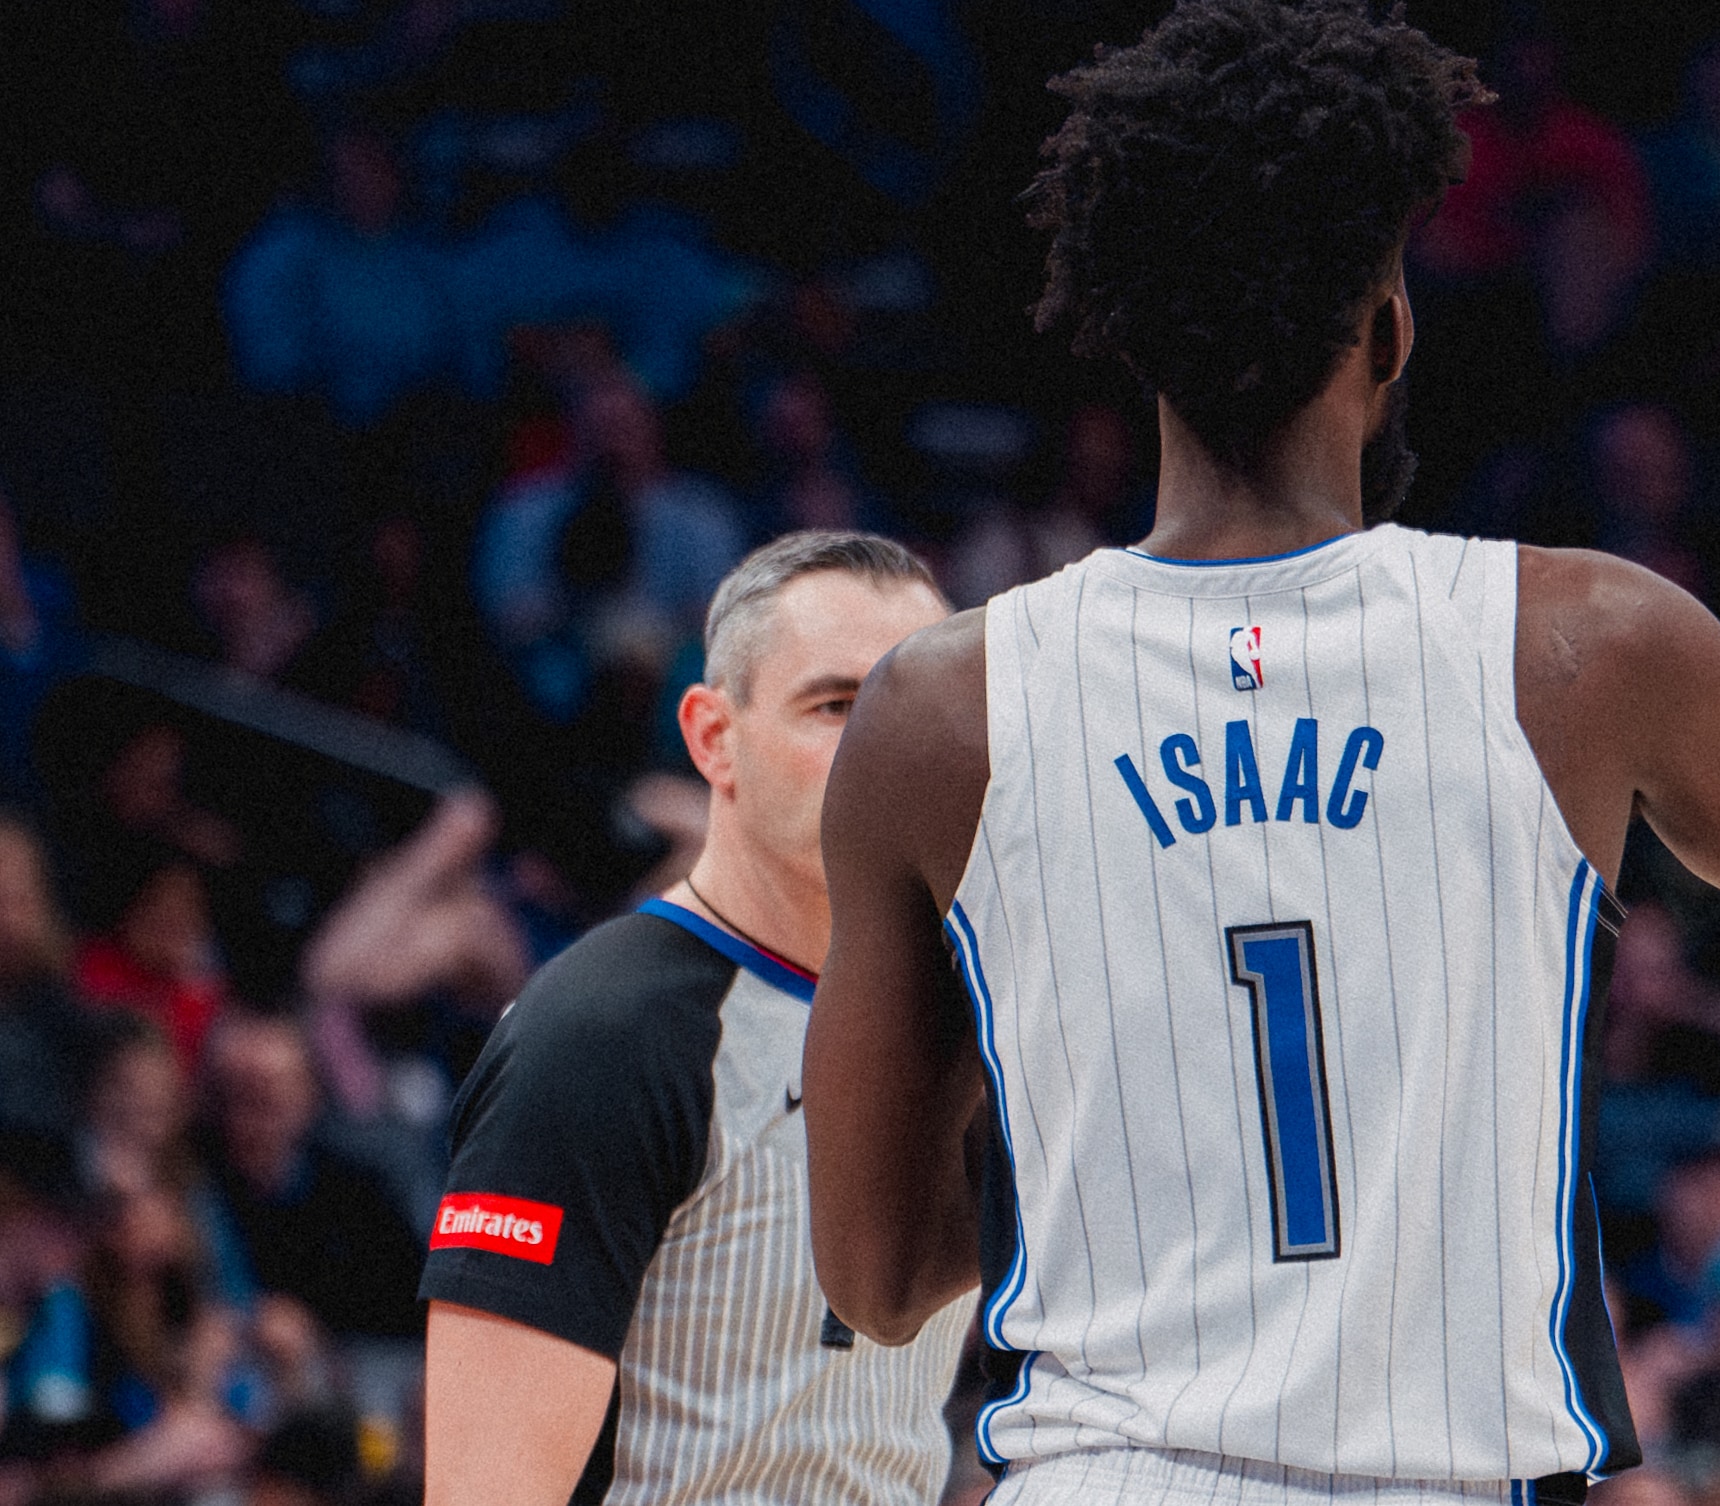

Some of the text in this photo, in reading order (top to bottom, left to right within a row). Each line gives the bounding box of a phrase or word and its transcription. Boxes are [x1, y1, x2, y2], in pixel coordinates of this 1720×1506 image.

[1113, 717, 1385, 850] ISAAC
[1224, 919, 1341, 1264] 1
[438, 1204, 544, 1245] Emirates
